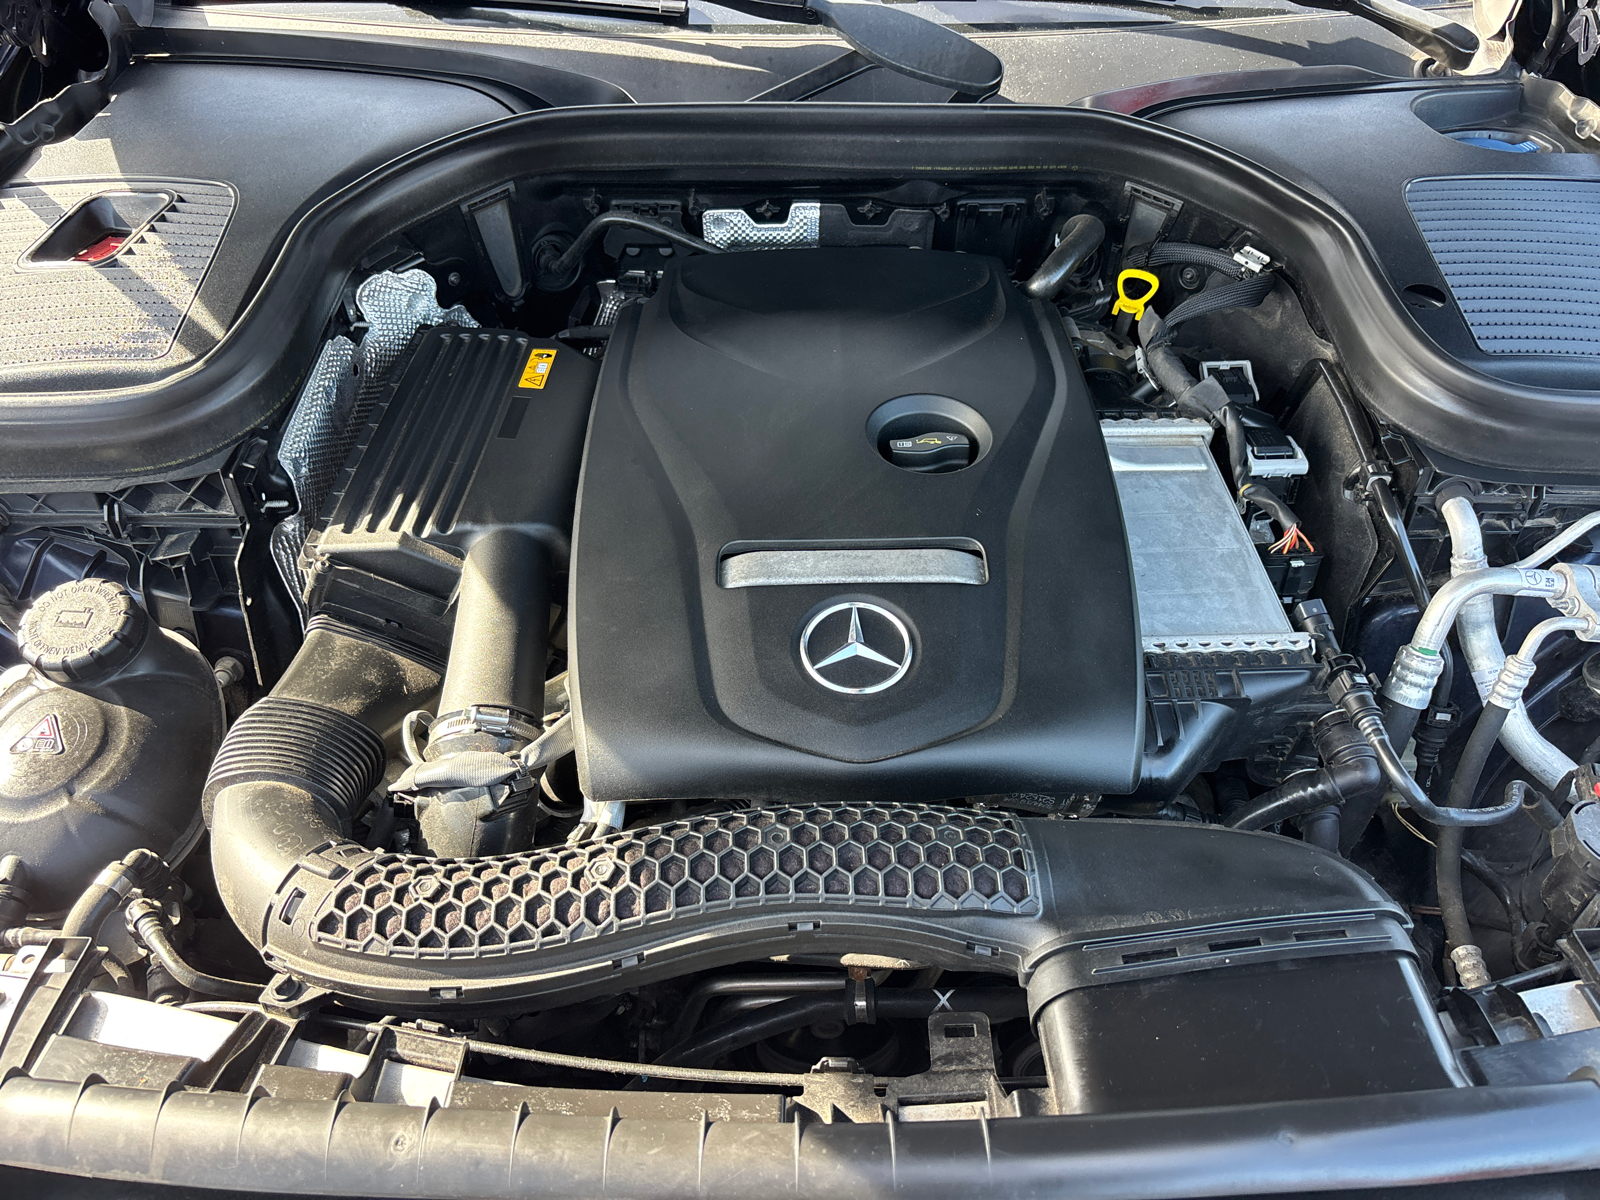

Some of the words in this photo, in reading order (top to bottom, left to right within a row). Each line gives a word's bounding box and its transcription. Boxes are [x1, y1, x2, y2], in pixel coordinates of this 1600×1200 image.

[38, 601, 50, 612] DO
[71, 585, 95, 594] OPEN
[96, 587, 116, 607] WHEN
[62, 641, 88, 655] WENN
[89, 625, 111, 645] HEISS
